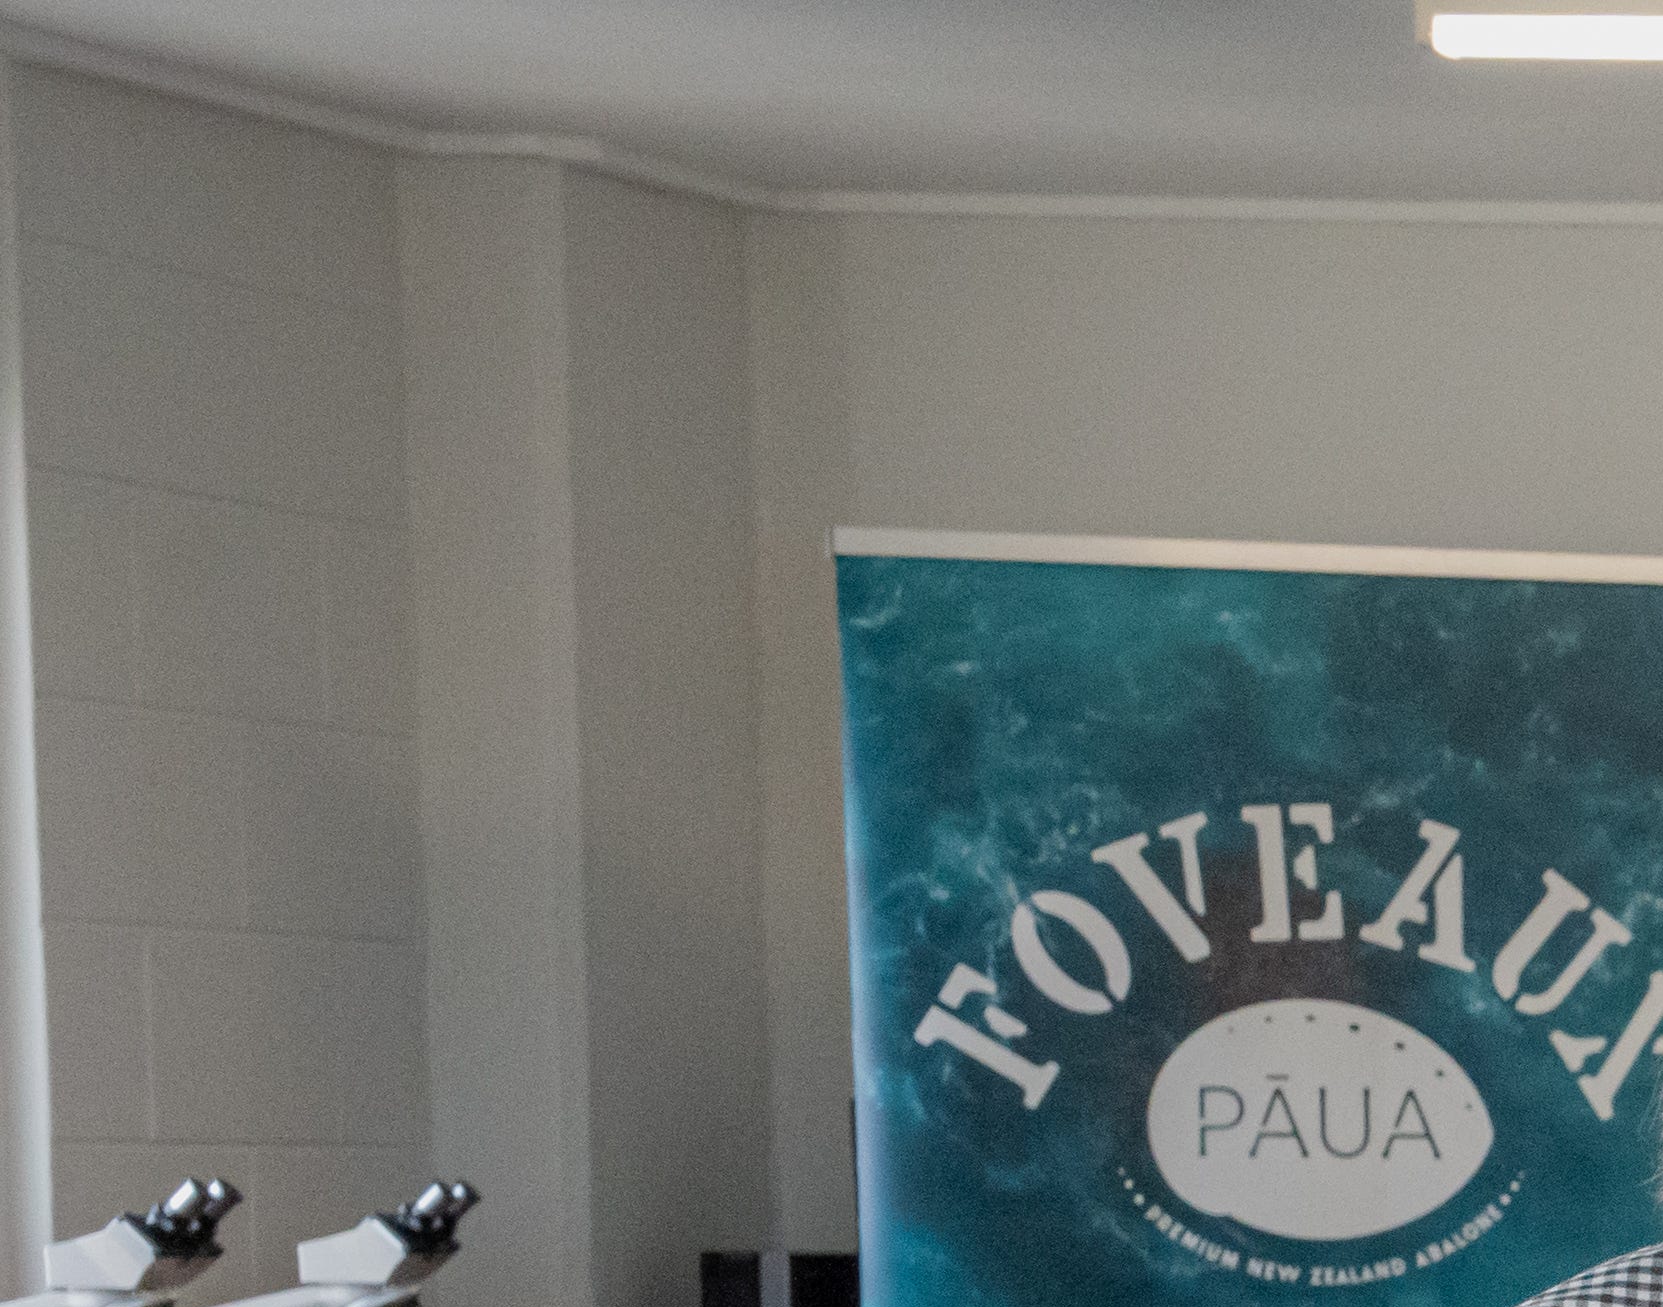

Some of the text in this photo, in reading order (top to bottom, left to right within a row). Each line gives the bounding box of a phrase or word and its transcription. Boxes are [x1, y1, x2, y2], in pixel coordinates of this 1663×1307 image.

[1198, 1074, 1442, 1160] PĀUA
[1145, 1203, 1502, 1287] PREMIUM NEW ZEALAND ABALONE
